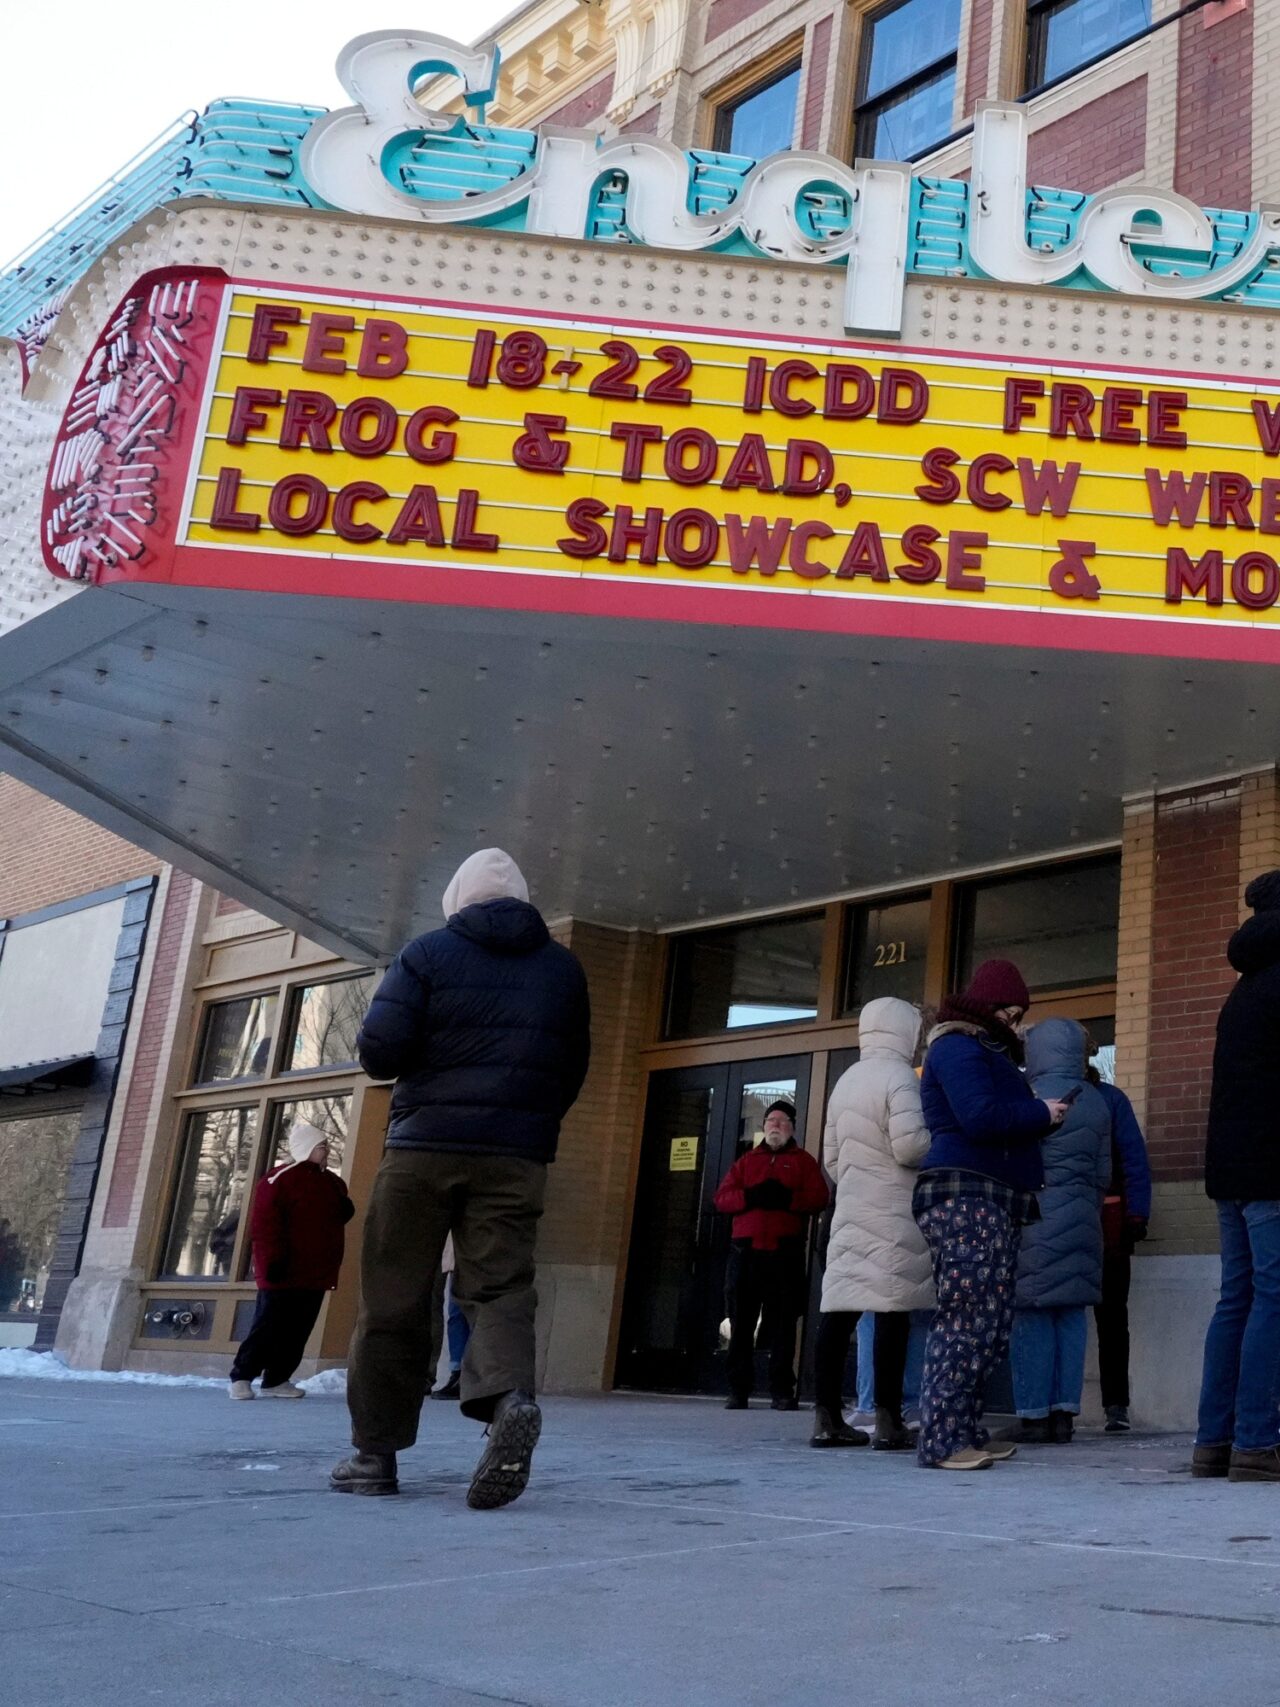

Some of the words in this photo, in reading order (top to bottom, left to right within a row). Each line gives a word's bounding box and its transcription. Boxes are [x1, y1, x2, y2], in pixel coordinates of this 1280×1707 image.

[244, 304, 411, 380] FEB
[468, 329, 695, 406] 18-22
[741, 355, 929, 426] ICDD
[1003, 377, 1189, 449] FREE
[226, 386, 461, 466] FROG
[512, 412, 570, 476] &
[610, 421, 854, 508] TOAD,
[914, 446, 1082, 518] SCW
[210, 466, 500, 552] LOCAL
[556, 496, 990, 593] SHOWCASE
[1047, 538, 1104, 601] &
[873, 941, 907, 967] 221
